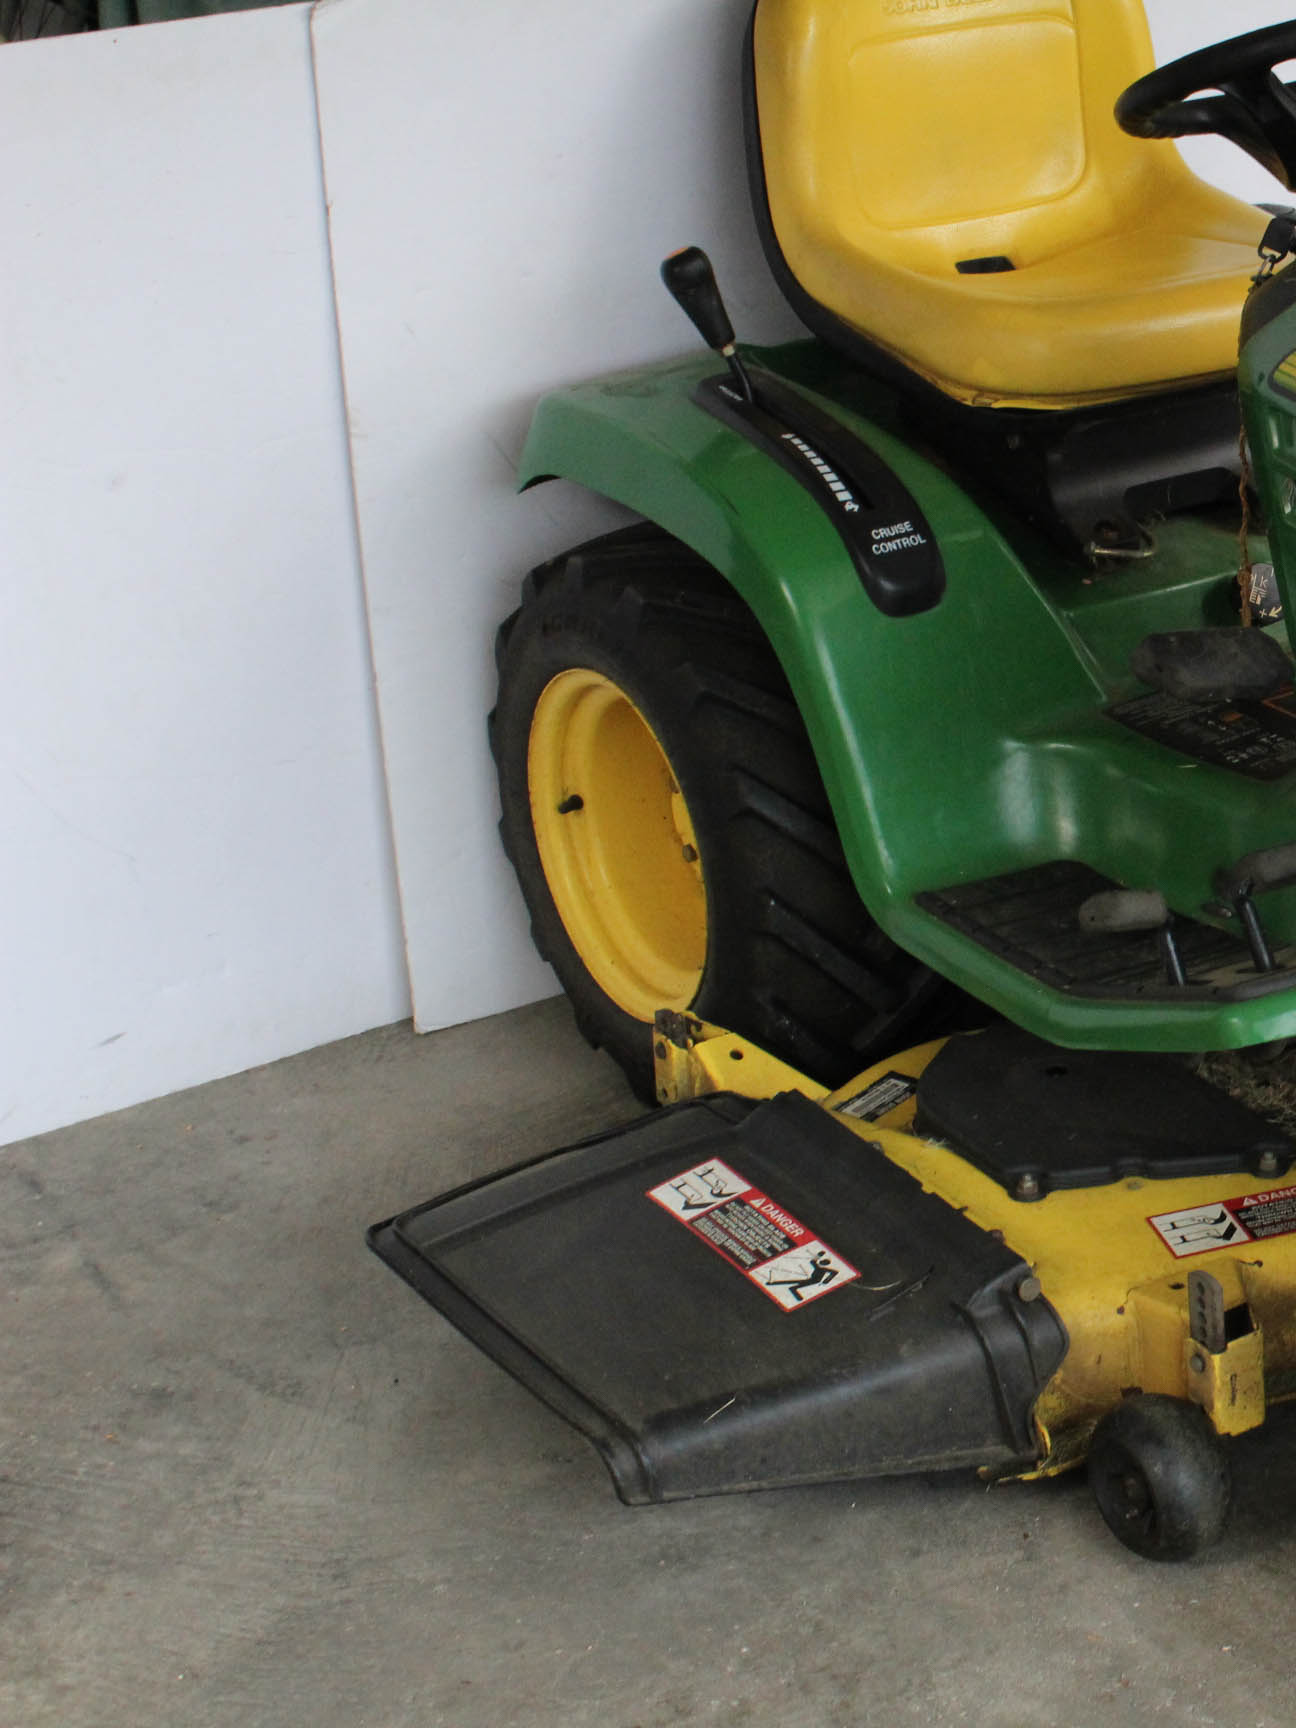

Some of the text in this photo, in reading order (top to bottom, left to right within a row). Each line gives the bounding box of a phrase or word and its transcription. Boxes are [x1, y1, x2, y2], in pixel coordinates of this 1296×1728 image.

[871, 520, 914, 540] CRUISE
[871, 533, 927, 556] CONTROL
[761, 1203, 805, 1238] DANGER
